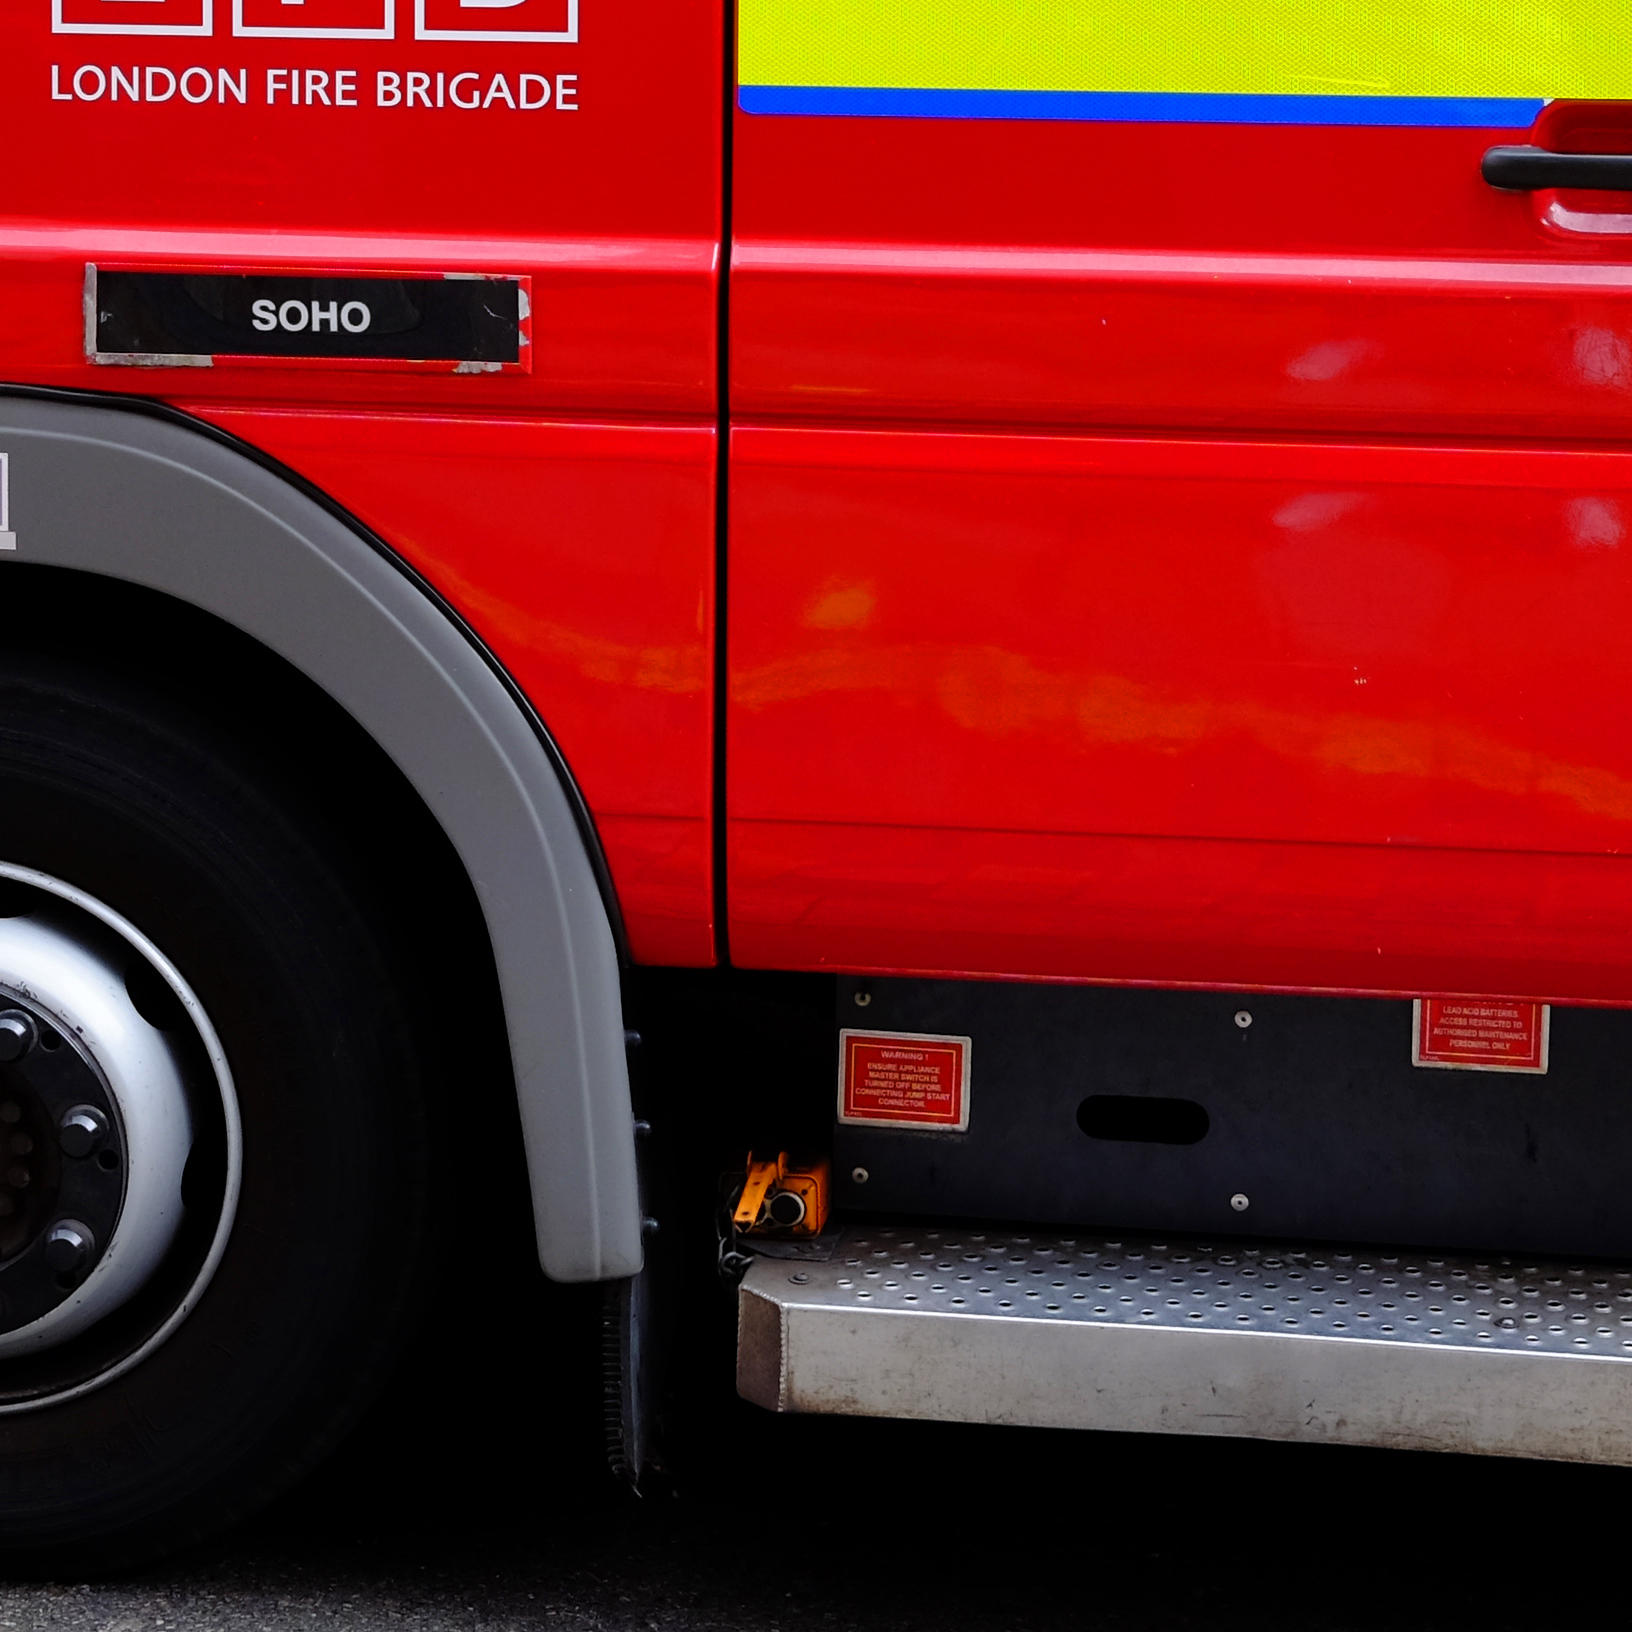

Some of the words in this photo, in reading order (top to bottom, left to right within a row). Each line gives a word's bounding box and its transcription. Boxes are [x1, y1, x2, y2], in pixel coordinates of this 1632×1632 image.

[51, 64, 248, 105] LONDON
[266, 68, 359, 107] FIRE
[376, 71, 579, 111] BRIGADE
[251, 299, 371, 334] SOHO
[1440, 1017, 1467, 1026] ACCESS
[1469, 1018, 1511, 1028] RESTRICTED
[1478, 1030, 1528, 1040] MAINTENANCE
[1492, 1042, 1511, 1050] ONLY
[881, 1050, 923, 1060] WARNING
[868, 1062, 897, 1071] ENSURE
[899, 1064, 940, 1074] APPLIANCE
[869, 1071, 899, 1080] MASTER
[901, 1073, 929, 1082] SWITCH
[864, 1079, 894, 1088] TURNED
[896, 1081, 910, 1089] OFF
[911, 1082, 941, 1091] BEFORE
[855, 1088, 903, 1098] CONNECTING
[904, 1091, 925, 1099] JUMP
[927, 1092, 950, 1100] START
